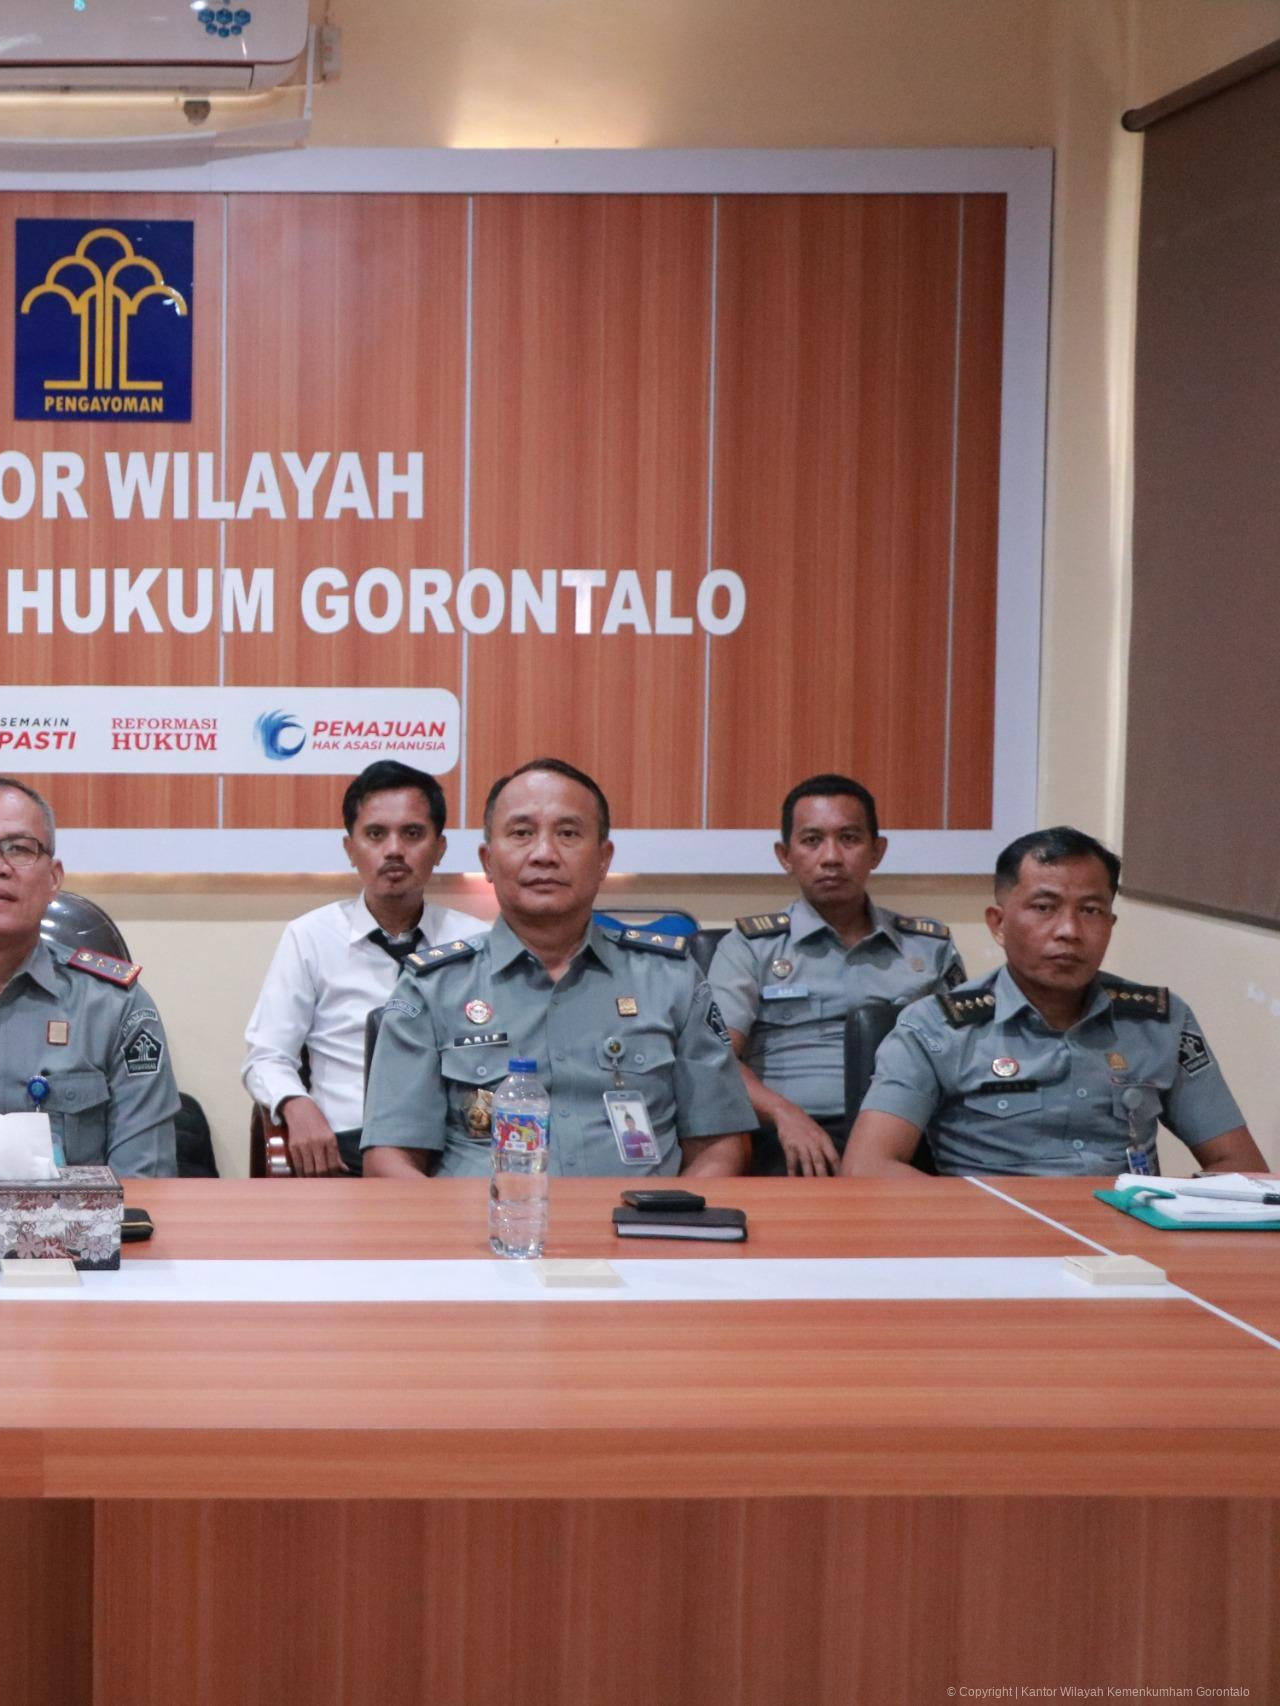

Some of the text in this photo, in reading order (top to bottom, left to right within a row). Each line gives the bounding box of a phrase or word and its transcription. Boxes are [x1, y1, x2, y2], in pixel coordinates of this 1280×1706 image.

[44, 395, 163, 413] PENGAYOMAN
[103, 450, 425, 521] WILAYAH
[6, 567, 275, 635] HUKUM
[300, 566, 746, 636] GORONTALO
[0, 717, 70, 727] SEMAKIN
[111, 717, 218, 730] REFORMASI
[312, 720, 446, 737] PEMAJUAN
[111, 732, 218, 751] HUKUM
[312, 740, 446, 751] HAK ASASI MANUSIA
[463, 1033, 499, 1045] ARIF
